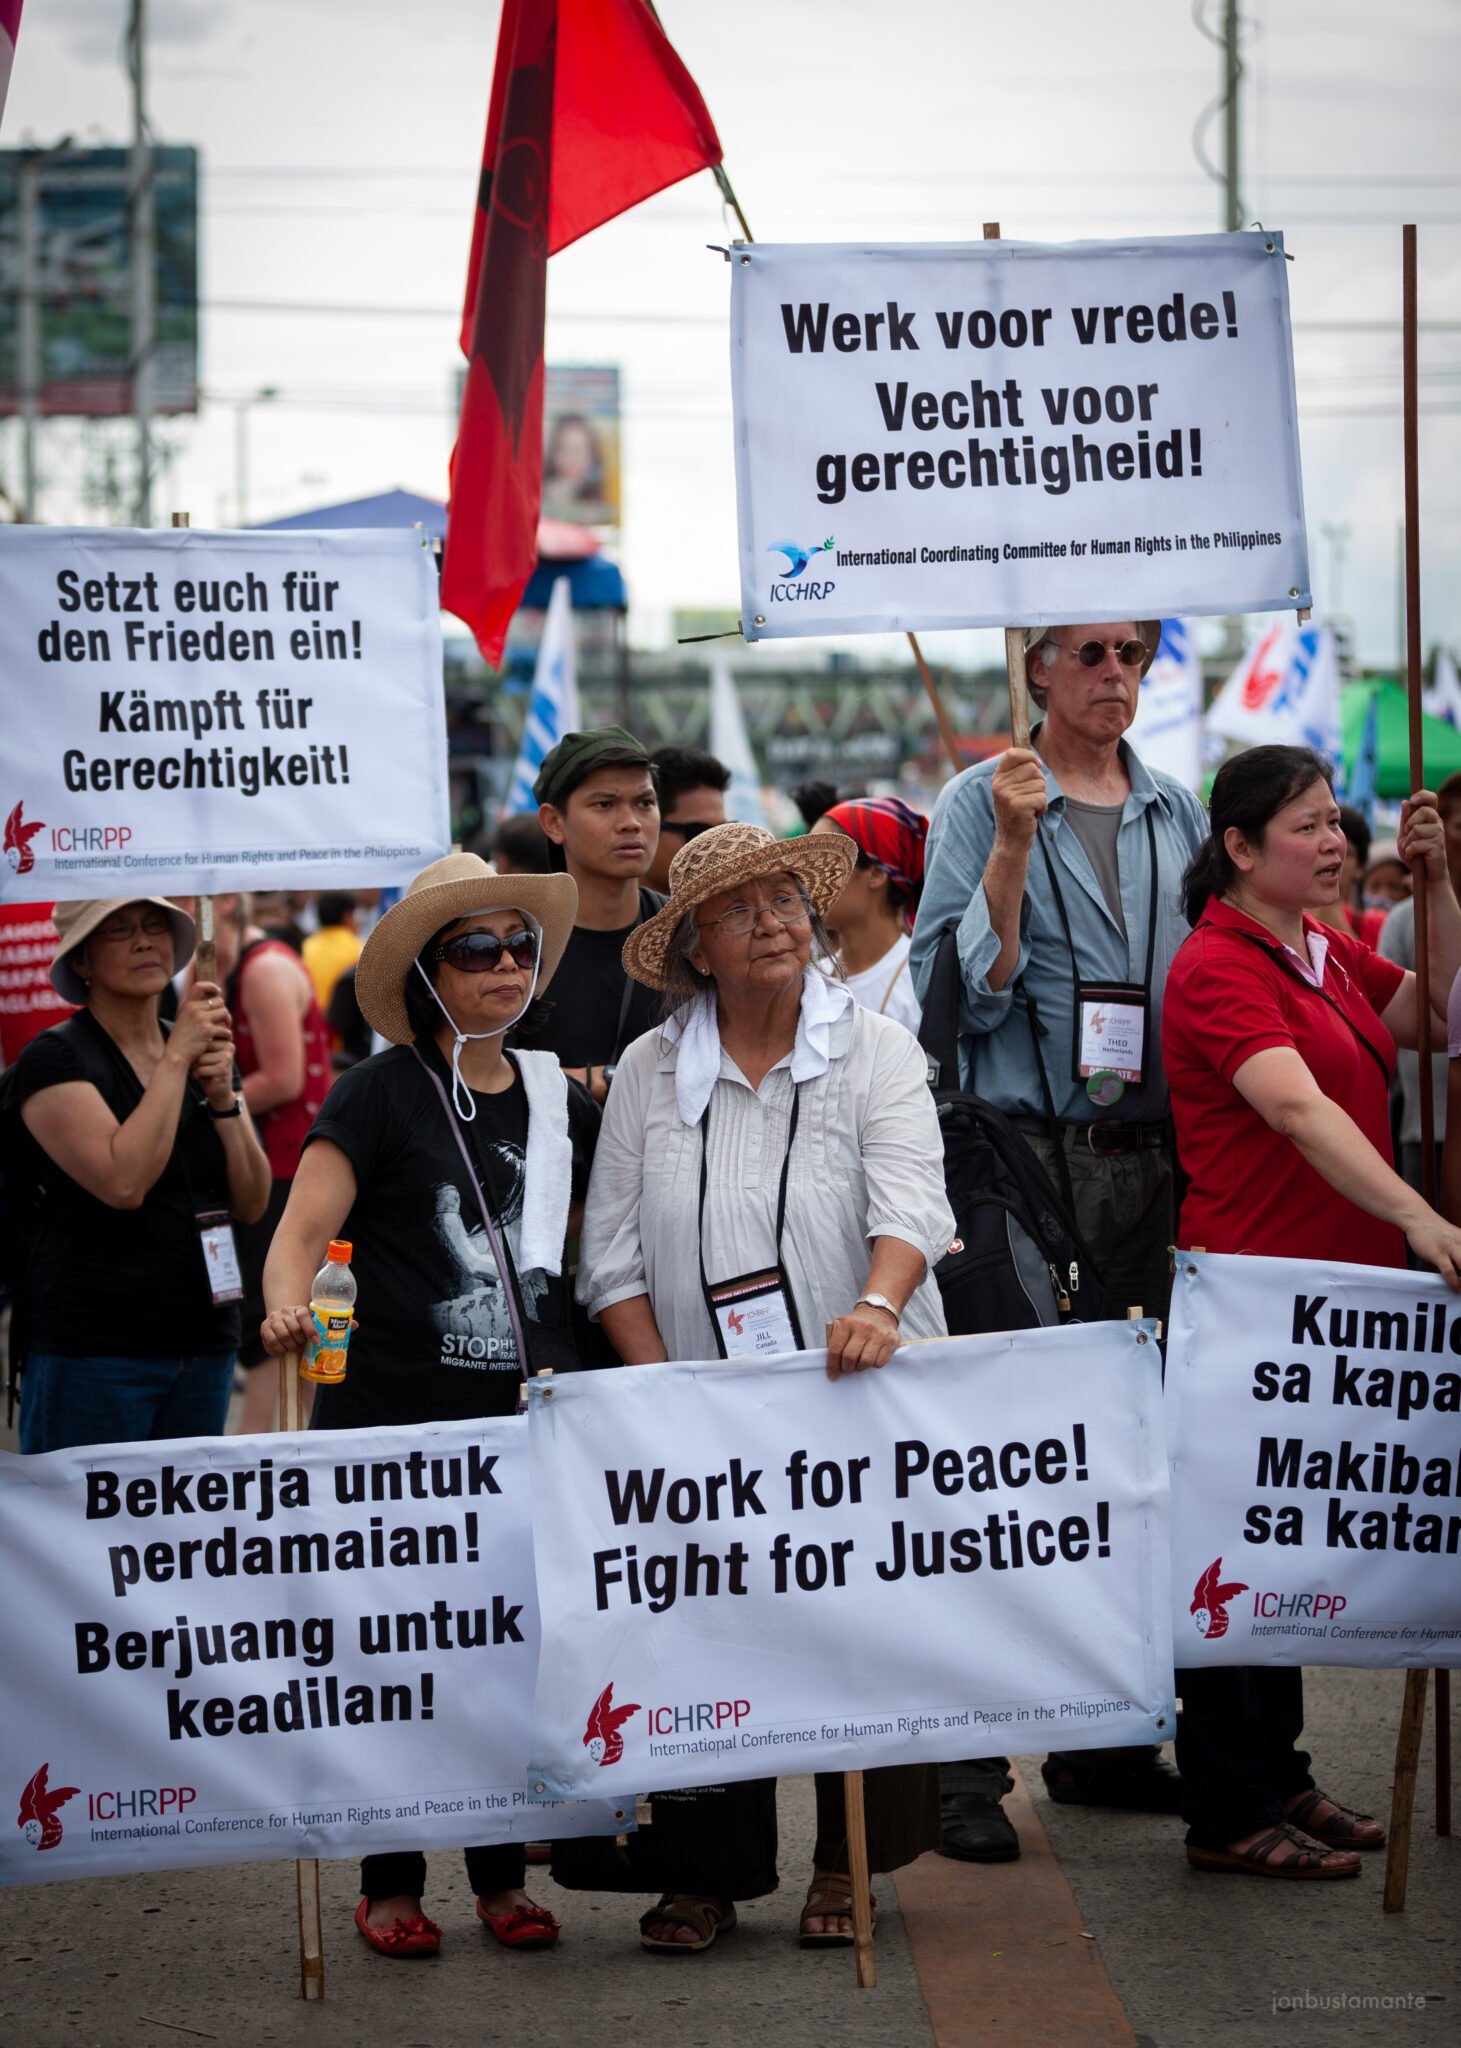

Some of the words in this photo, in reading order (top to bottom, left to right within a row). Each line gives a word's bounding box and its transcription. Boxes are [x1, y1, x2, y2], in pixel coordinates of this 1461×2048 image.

[781, 301, 920, 354] Werk
[935, 307, 1052, 350] voor
[1071, 290, 1239, 345] vrede!
[874, 378, 1025, 432] Vecht
[1041, 381, 1159, 426] voor
[815, 428, 1202, 504] gerechtigheid!
[836, 548, 916, 567] International
[921, 544, 999, 564] Coordinating
[1003, 541, 1067, 560] Committee
[1070, 540, 1087, 556] for
[1091, 539, 1131, 555] Human
[1135, 536, 1172, 556] Rights
[1175, 535, 1187, 550] in
[1190, 534, 1210, 550] the
[1213, 530, 1282, 551] Philippines
[56, 569, 159, 613] Setzt
[174, 572, 269, 613] euch
[282, 571, 339, 612] für
[770, 581, 835, 602] ICCHRP
[38, 621, 111, 662] den
[124, 621, 275, 662] Frieden
[290, 620, 362, 660] ein!
[99, 689, 245, 740] Kämpft
[256, 688, 313, 729] für
[63, 745, 350, 797] Gerechtigkeit!
[51, 827, 132, 852] ICHRPP
[54, 855, 121, 871] International
[123, 854, 183, 868] Conference
[184, 853, 199, 866] for
[201, 852, 239, 866] Human
[241, 851, 274, 866] Rights
[276, 850, 296, 863] and
[299, 849, 328, 862] Peace
[330, 848, 342, 860] in
[344, 847, 362, 859] the
[364, 845, 421, 859] Philippines
[1108, 1038, 1128, 1047] THEO
[441, 1333, 500, 1359] STOP
[756, 1331, 771, 1342] JILL
[756, 1340, 777, 1350] Canada
[440, 1355, 488, 1371] MIGRANTE
[1252, 1361, 1311, 1404] sa
[85, 1459, 310, 1521] Bekerja
[334, 1445, 502, 1505] untuk
[605, 1458, 767, 1525] Work
[785, 1450, 870, 1511] for
[894, 1423, 1090, 1499] Peace!
[1243, 1504, 1304, 1546] sa
[108, 1512, 480, 1597] perdamaian!
[593, 1541, 749, 1614] Fight
[769, 1533, 854, 1593] for
[875, 1501, 1112, 1582] Justice!
[1253, 1592, 1346, 1620] ICHRPP
[75, 1613, 335, 1679] Berjuang
[359, 1595, 525, 1656] untuk
[1251, 1623, 1327, 1638] International
[1331, 1626, 1397, 1639] Conference
[1400, 1627, 1417, 1640] for
[1420, 1628, 1461, 1640] Human
[166, 1673, 435, 1741] keadilan!
[648, 1700, 751, 1736] ICHRPP
[650, 1735, 737, 1757] International
[741, 1729, 817, 1748] Conference
[821, 1725, 840, 1740] for
[844, 1722, 893, 1738] Human
[898, 1716, 940, 1735] Rights
[944, 1712, 969, 1727] and
[974, 1710, 1013, 1725] Peace
[1017, 1708, 1030, 1721] in
[1034, 1705, 1056, 1720] the
[1060, 1699, 1130, 1719] Philippines
[88, 1787, 196, 1821] ICHRPP
[90, 1821, 180, 1842] International
[185, 1816, 264, 1834] Conference
[269, 1814, 288, 1828] for
[292, 1811, 342, 1827] Human
[348, 1808, 391, 1826] Rights
[395, 1802, 420, 1818] and
[425, 1800, 464, 1815] Peace
[468, 1796, 481, 1811] in
[486, 1794, 508, 1810] the
